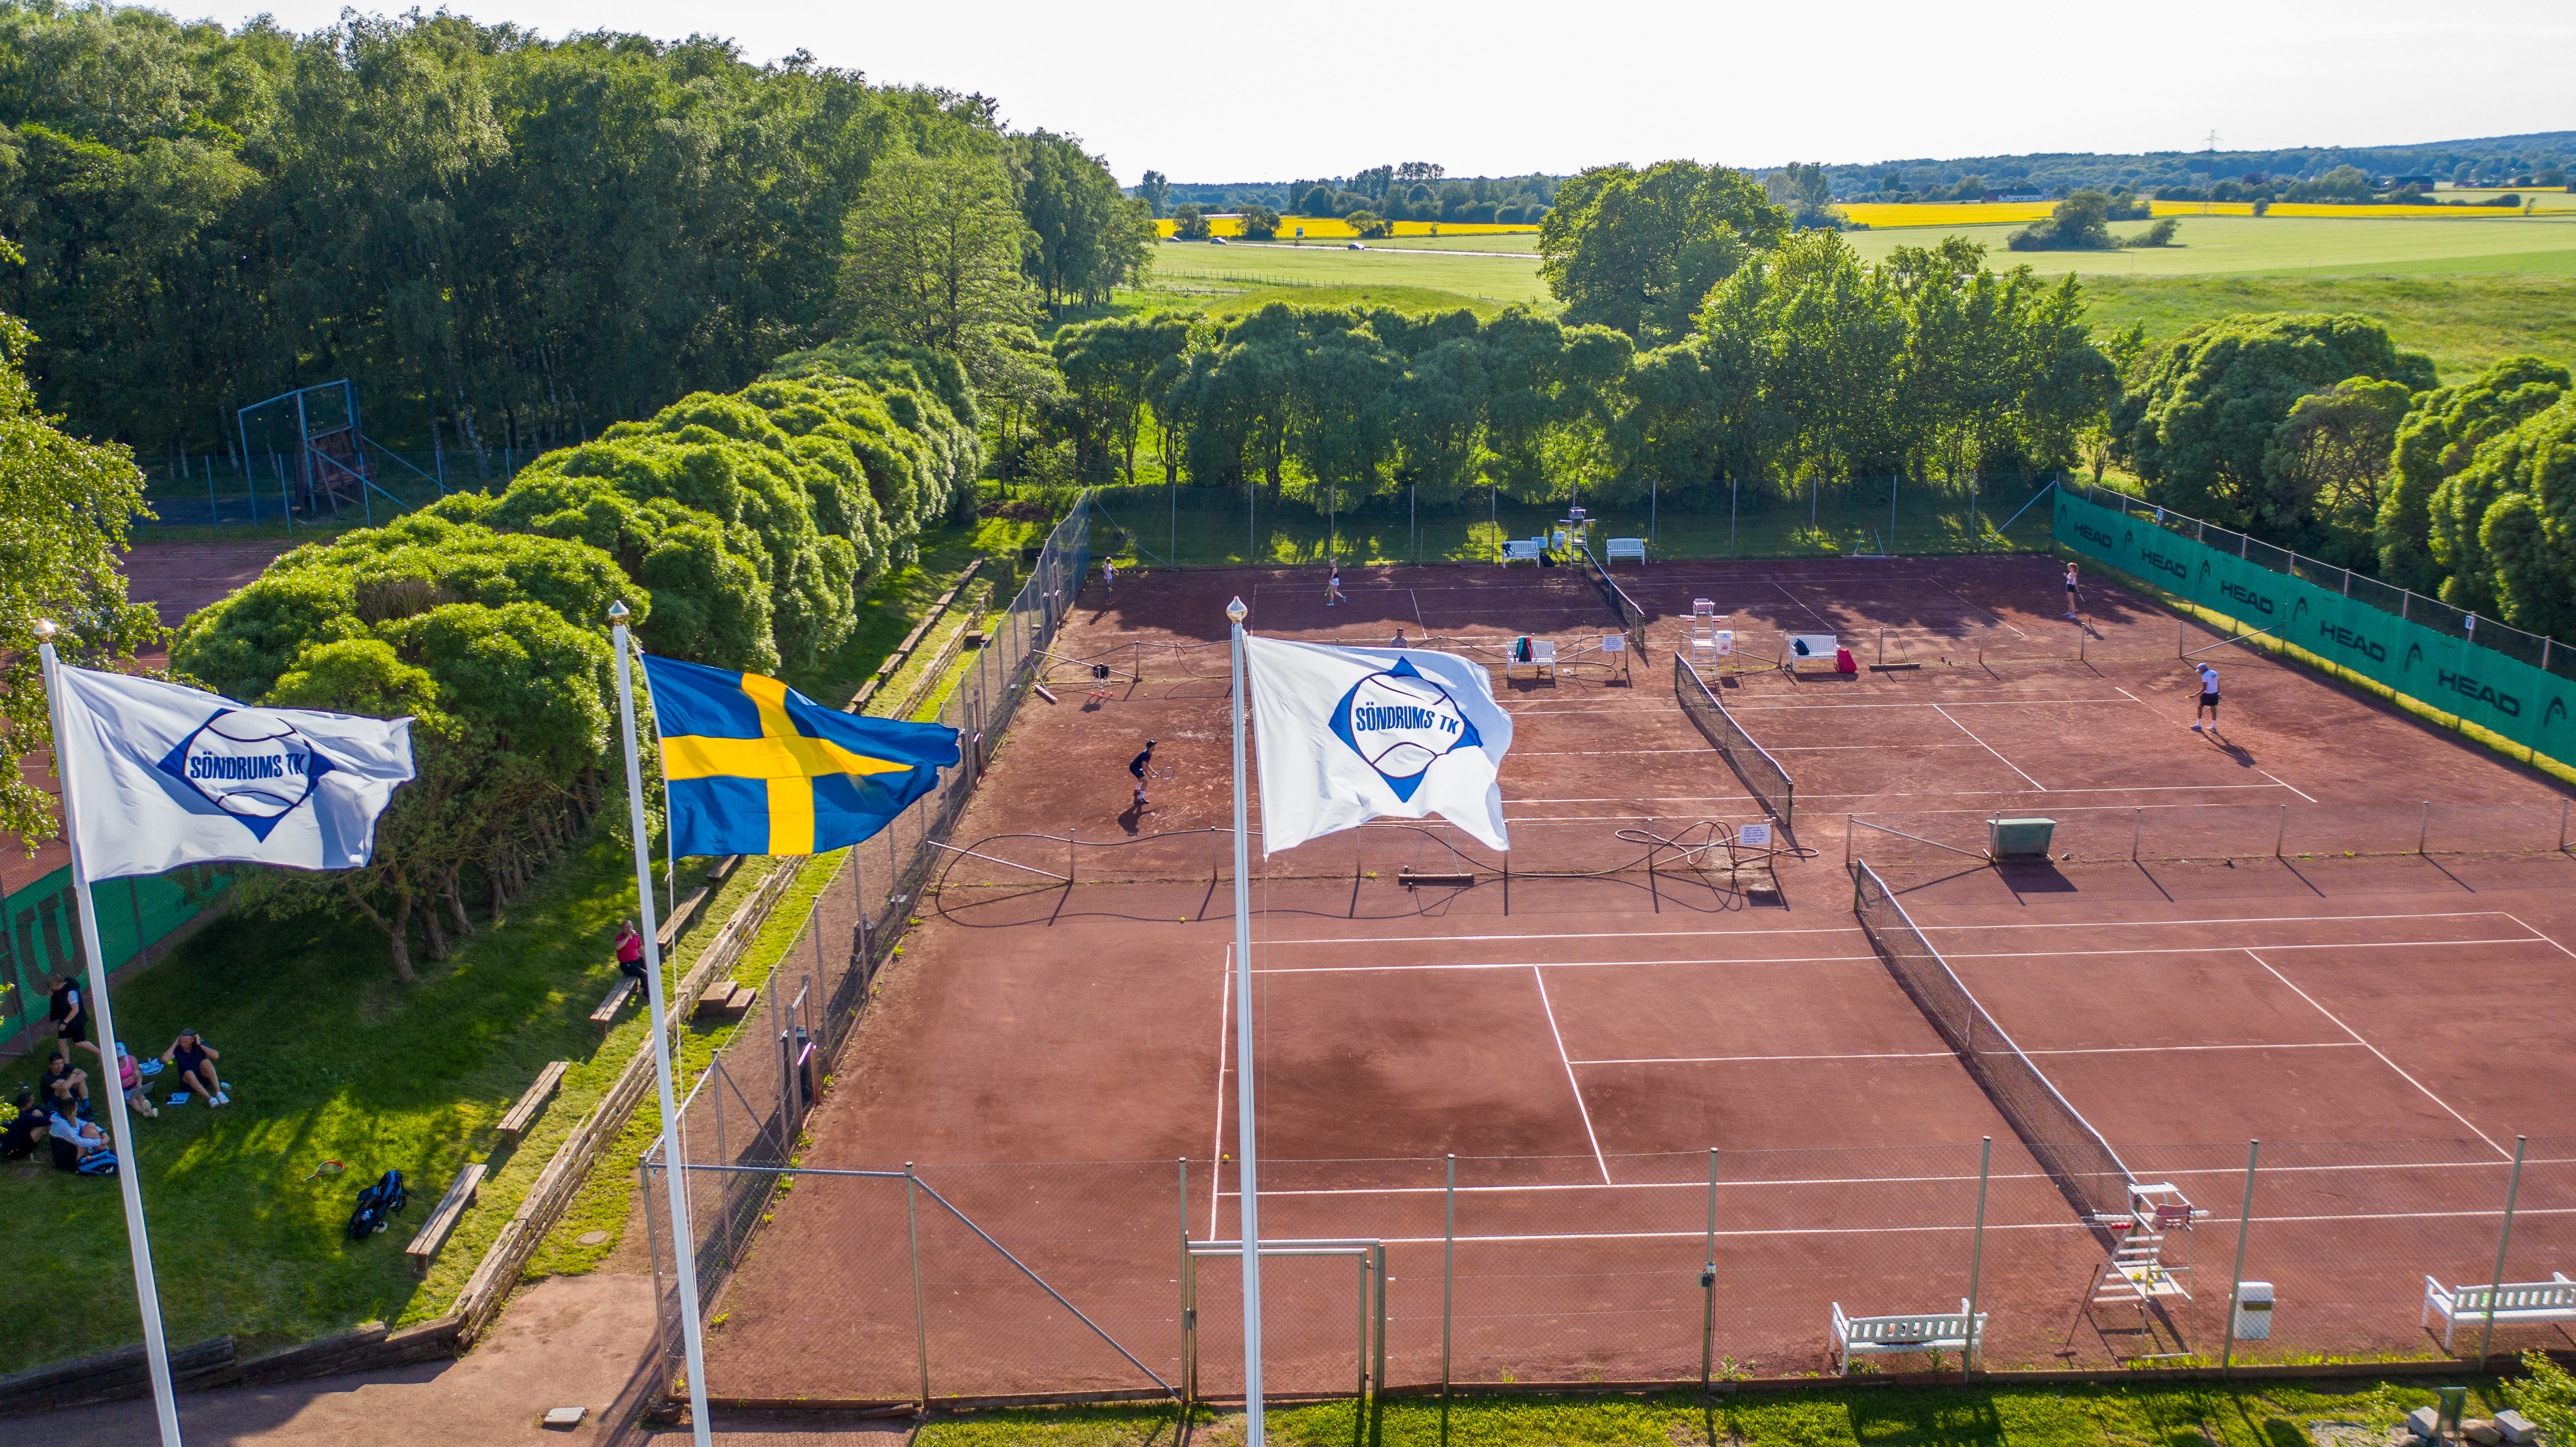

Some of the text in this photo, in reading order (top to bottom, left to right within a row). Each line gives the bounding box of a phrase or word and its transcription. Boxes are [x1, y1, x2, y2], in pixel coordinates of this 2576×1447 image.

[2074, 521, 2112, 549] HEAD
[2142, 548, 2186, 579] HEAD
[2221, 580, 2273, 615] HEAD
[2320, 620, 2386, 663] HEAD
[2438, 668, 2519, 717] HEAD
[1356, 702, 1459, 734] SÖNDRUMS TK
[190, 751, 306, 780] SÖNDRUMS TK
